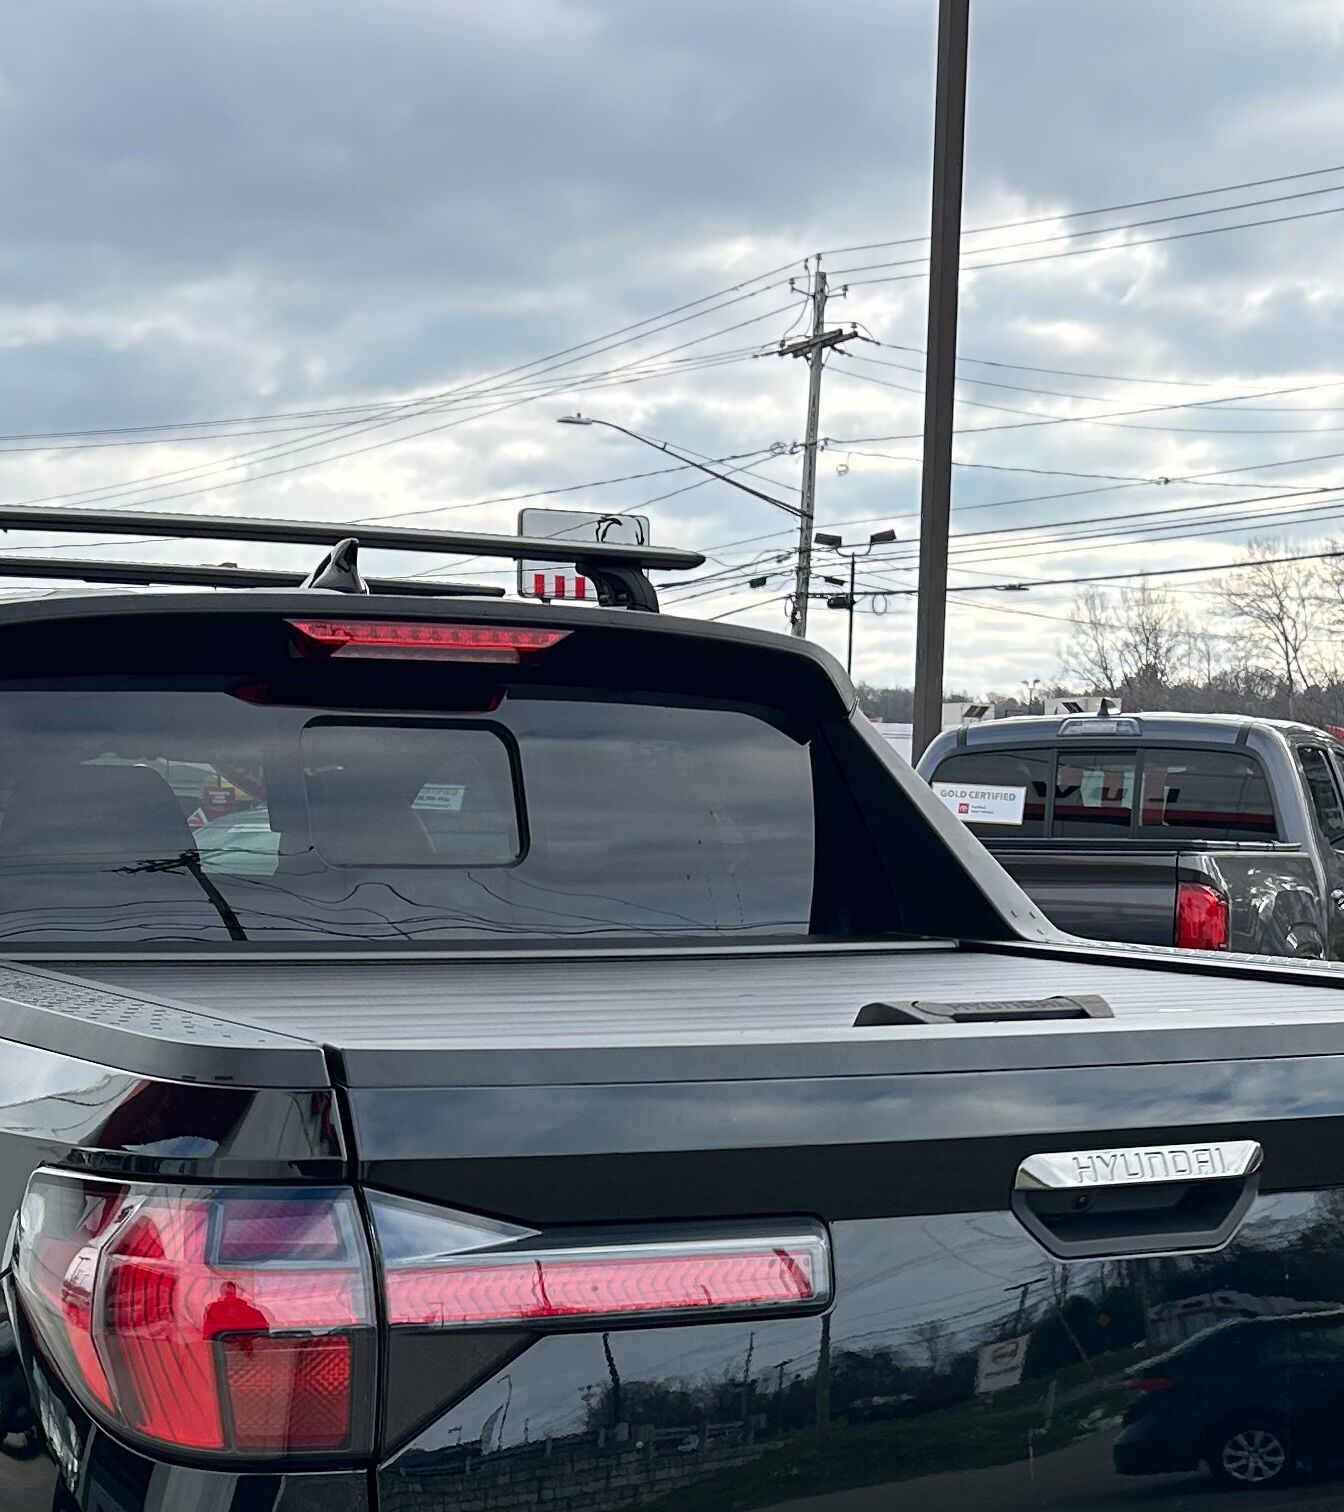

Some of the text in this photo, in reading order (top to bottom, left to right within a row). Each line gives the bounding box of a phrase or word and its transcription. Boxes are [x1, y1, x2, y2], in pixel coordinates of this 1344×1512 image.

[940, 789, 1017, 802] GOLD CERTIFIED
[1072, 1147, 1228, 1184] HYUNDAI
